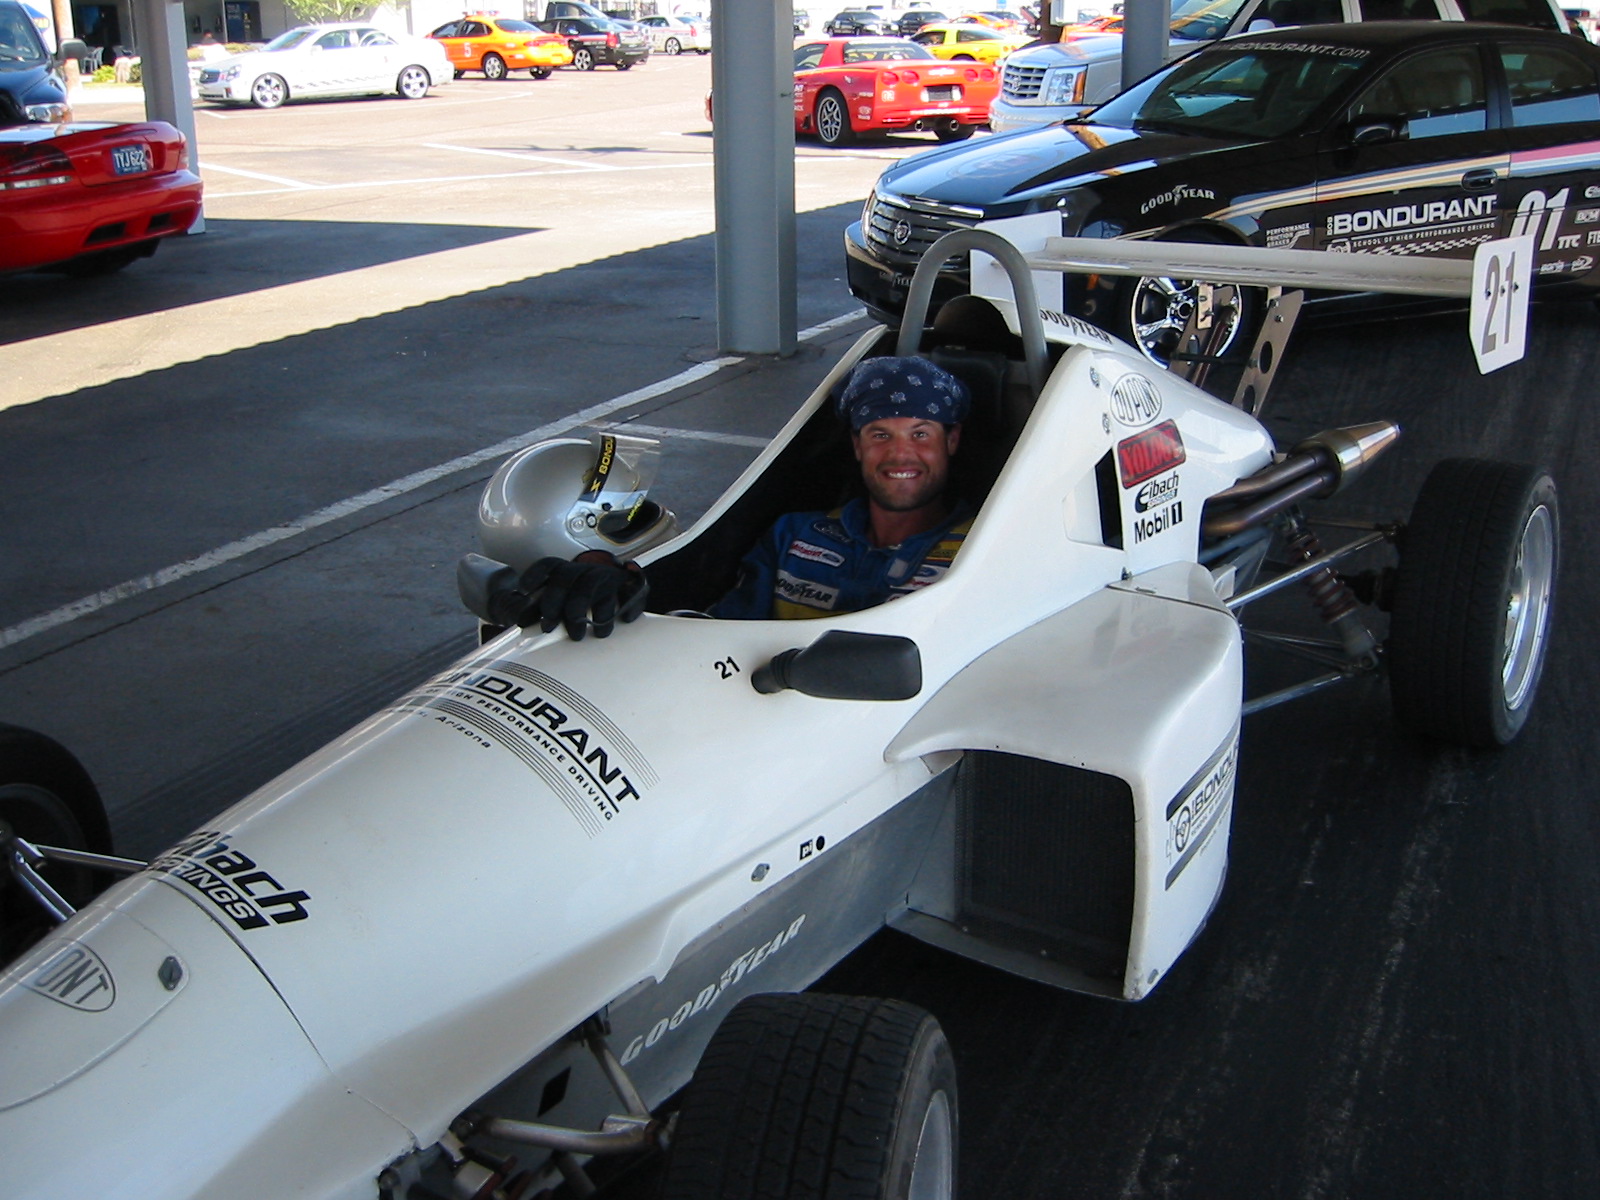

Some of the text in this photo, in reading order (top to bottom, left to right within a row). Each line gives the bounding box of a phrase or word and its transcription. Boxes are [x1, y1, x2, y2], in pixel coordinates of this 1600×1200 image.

[464, 42, 472, 57] 5
[1140, 184, 1215, 214] GOODYEAR
[1333, 194, 1498, 235] BONDURANT
[1353, 238, 1382, 248] SCHOOL
[1415, 228, 1465, 239] PERFORMANCE
[1467, 221, 1496, 232] DRIVING
[1481, 250, 1516, 355] 21
[1040, 309, 1113, 345] OODYEAR
[1134, 470, 1179, 514] Eibach
[1134, 501, 1183, 545] Mobil 1
[713, 656, 741, 680] 21
[434, 716, 493, 750] Arizona
[440, 671, 641, 803] NDURANT
[477, 698, 566, 763] PERFORMANCE
[567, 766, 612, 821] DRIVING
[619, 914, 807, 1067] GOODYEAR
